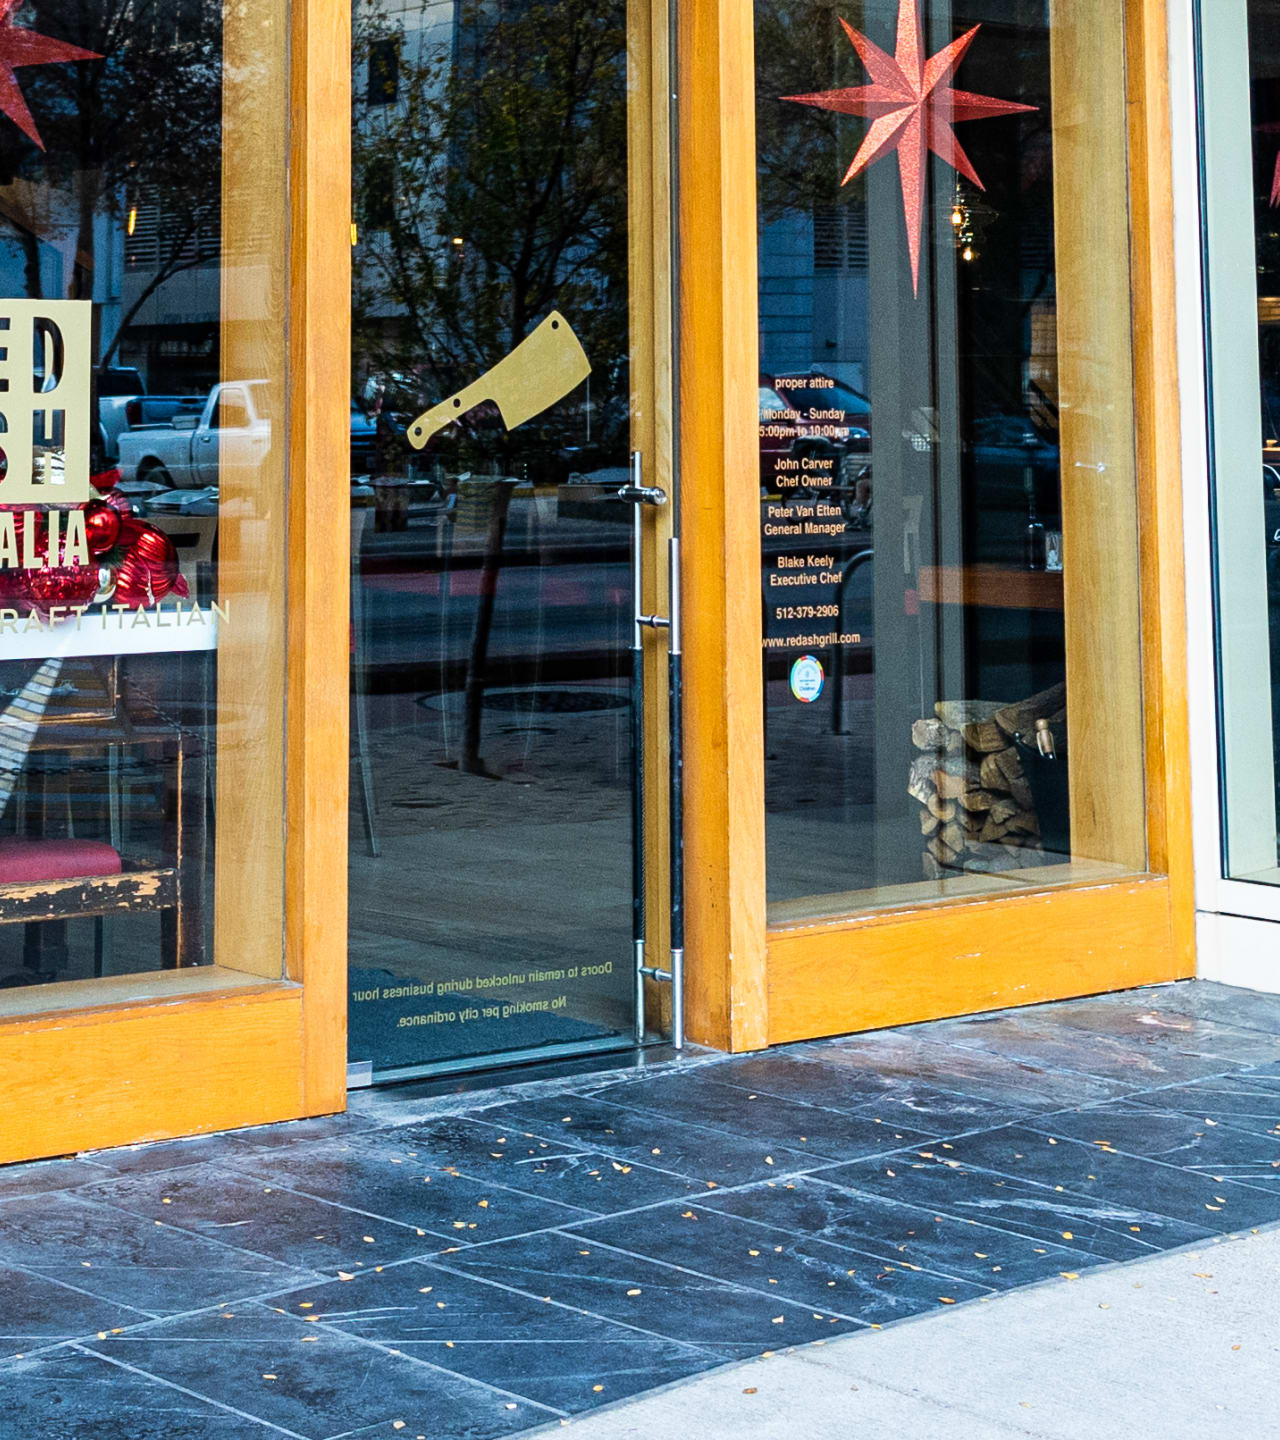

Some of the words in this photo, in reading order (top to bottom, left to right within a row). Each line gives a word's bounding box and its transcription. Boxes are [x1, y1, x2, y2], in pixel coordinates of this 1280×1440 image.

[775, 378, 807, 391] proper
[809, 377, 834, 389] attire
[762, 408, 801, 422] Monday
[809, 408, 846, 422] Sunday
[759, 426, 795, 439] 5:00pm
[797, 426, 808, 437] to
[774, 458, 799, 470] John
[801, 457, 834, 469] Carver
[776, 475, 799, 488] Chef
[801, 475, 833, 487] Owner
[768, 506, 794, 518] Peter
[796, 505, 814, 517] Van
[816, 504, 841, 516] Etten
[764, 523, 802, 535] General
[805, 522, 846, 537] Manager
[777, 556, 805, 568] Blake
[807, 555, 834, 569] Keely
[770, 572, 817, 586] Executive
[819, 571, 843, 584] Chef
[97, 599, 232, 631] ITALIAN
[776, 605, 839, 620] 512-379-2906
